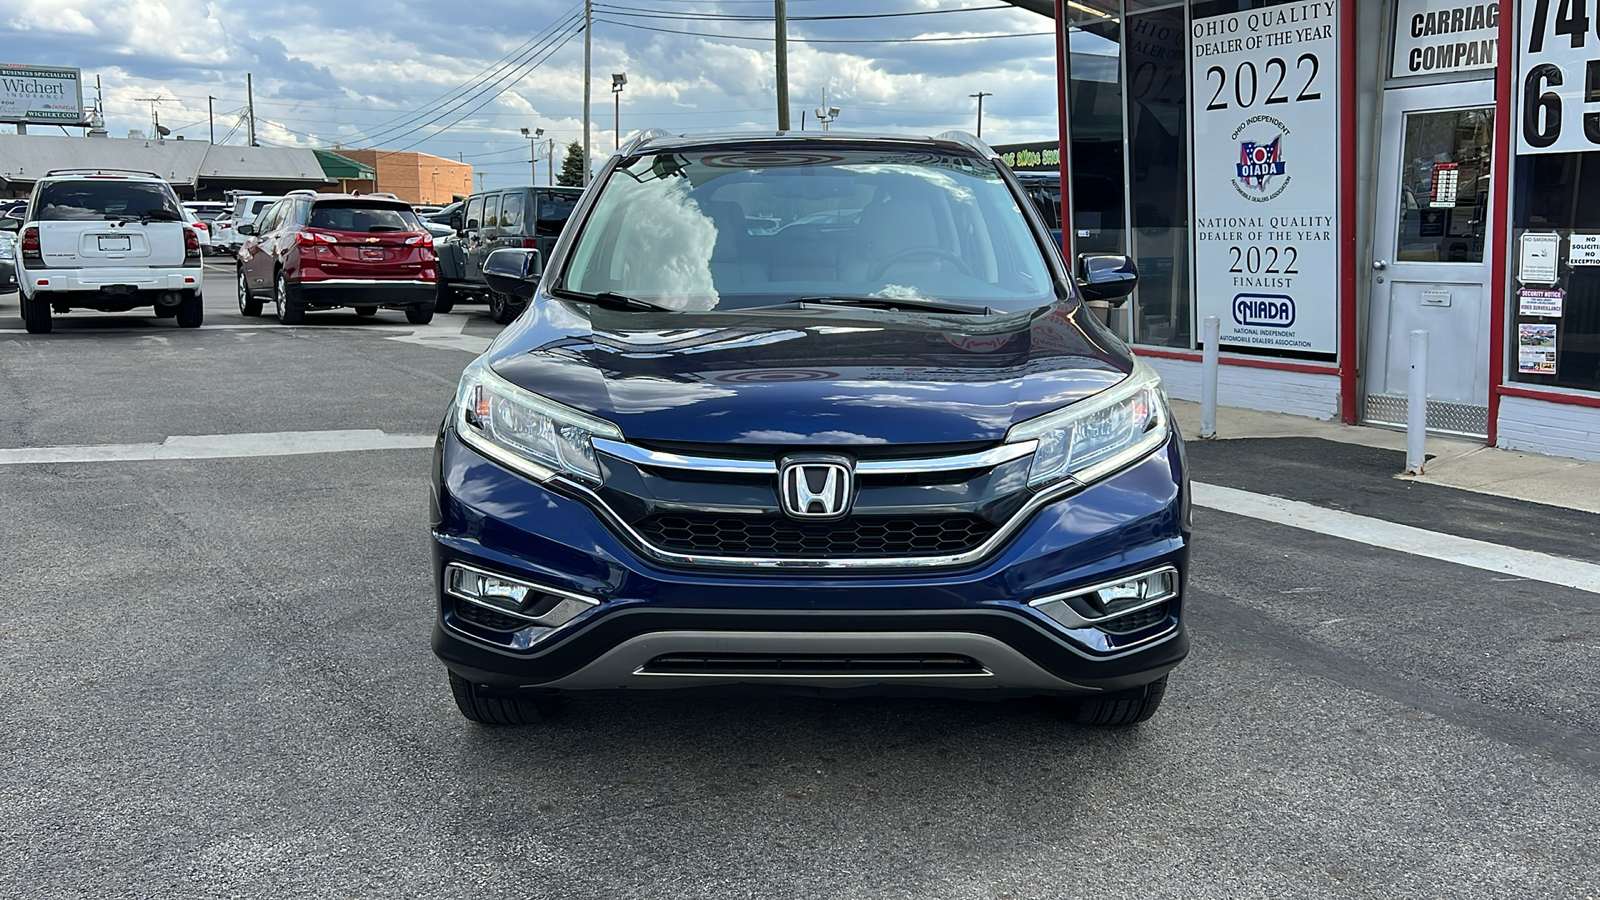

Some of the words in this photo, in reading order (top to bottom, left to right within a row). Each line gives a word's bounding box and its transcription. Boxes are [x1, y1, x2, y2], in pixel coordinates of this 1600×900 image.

[1194, 17, 1239, 38] OHIO
[1248, 1, 1335, 31] QUALITY
[1411, 3, 1499, 38] CARRIAG
[1528, 0, 1600, 53] 74
[1196, 38, 1243, 57] DEALER
[1246, 35, 1263, 50] OF
[1266, 31, 1292, 47] THE
[1296, 25, 1332, 43] YEAR
[1409, 39, 1498, 72] COMPAN
[2, 78, 65, 95] Wichert
[1206, 53, 1321, 111] 2022
[1232, 123, 1246, 140] OHIO
[1246, 115, 1290, 135] INDEPENDENT
[1042, 148, 1060, 166] SHO
[1242, 163, 1277, 176] OIADA
[1231, 179, 1251, 201] AUTOMOBILE
[1270, 175, 1291, 200] ASSOCIATION
[1198, 217, 1264, 228] NATIONAL
[1270, 216, 1332, 229] QUALITY
[1200, 232, 1243, 241] DEALER
[1248, 232, 1263, 241] OF
[1268, 232, 1292, 240] THE
[1298, 231, 1331, 241] YEAR
[1229, 246, 1299, 274] 2022
[1233, 277, 1292, 288] FINALIST
[1238, 301, 1289, 320] NIADA
[1220, 335, 1251, 343] AUTOMOBILE
[1275, 339, 1311, 347] ASSOCIATION
[1260, 329, 1295, 337] INDEPENDENT
